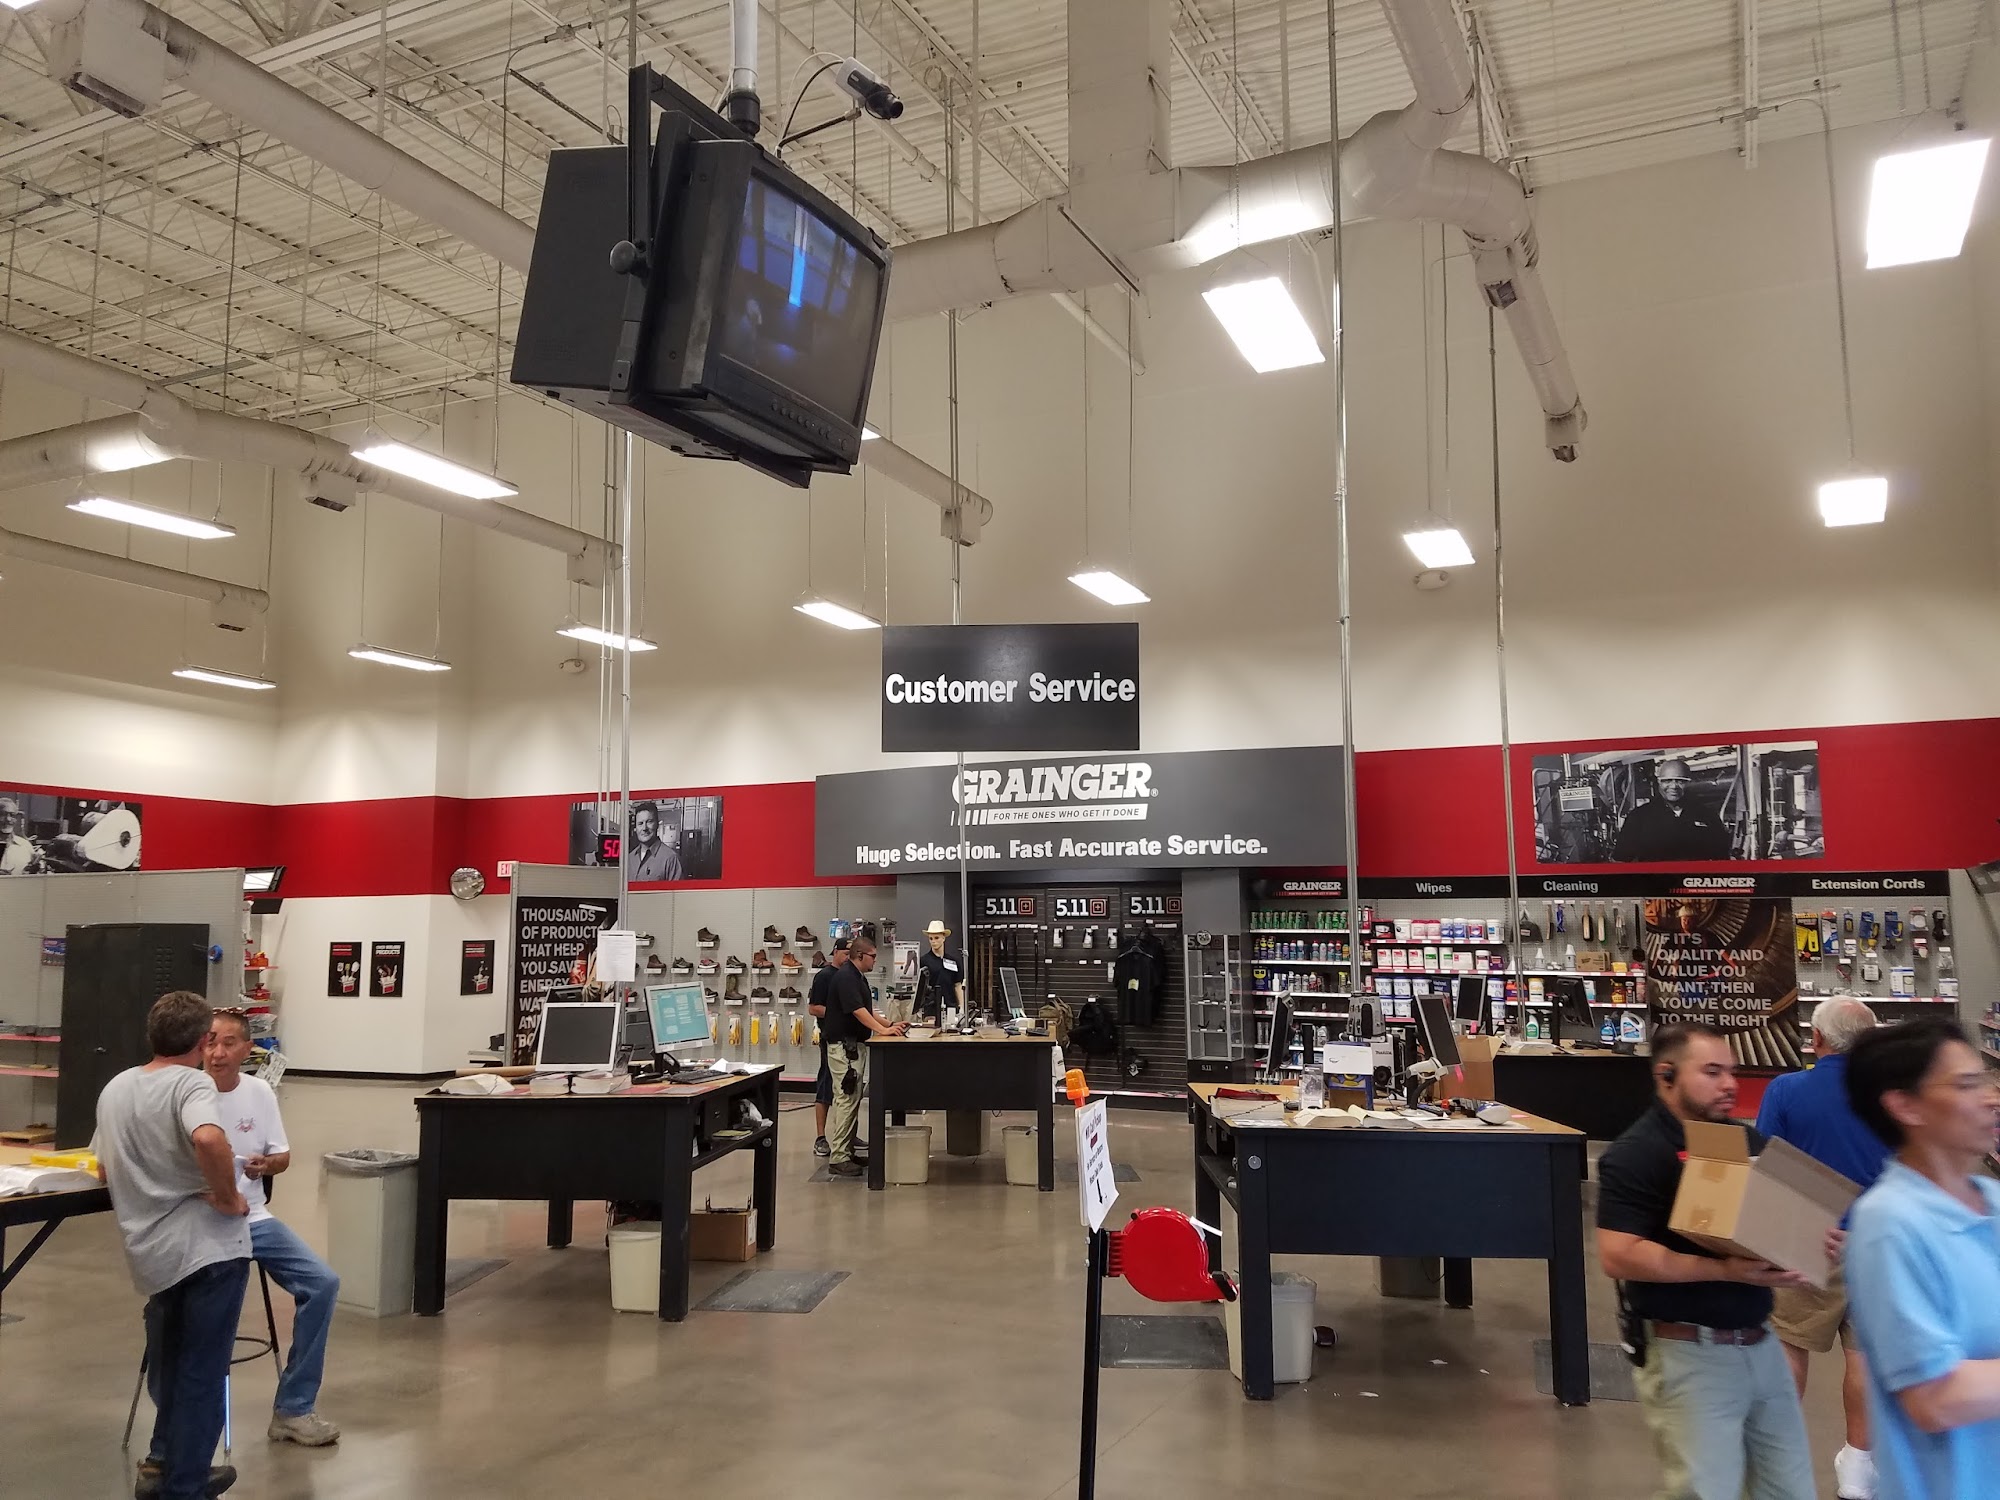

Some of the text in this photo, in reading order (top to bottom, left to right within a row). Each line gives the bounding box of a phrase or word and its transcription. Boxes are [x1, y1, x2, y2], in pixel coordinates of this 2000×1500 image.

[885, 672, 1136, 704] Customer Service
[951, 762, 1152, 805] GRAINGER
[993, 808, 1140, 820] FOR THE ONES WHO GET IT DONE
[856, 846, 901, 867] Huge
[1009, 839, 1053, 859] Fast
[1058, 837, 1162, 858] Accurate
[1167, 834, 1268, 856] Service.
[1283, 881, 1342, 891] GRAINGER
[1415, 882, 1452, 895] Wipes
[1543, 880, 1599, 894] Cleaning
[1682, 877, 1756, 888] GRAINGER
[1811, 878, 1926, 890] Extension Cords
[985, 897, 1018, 915] 5.11
[1056, 898, 1089, 917] 5.11
[1130, 896, 1165, 915] 5.11
[521, 908, 596, 922] THOUSANDS
[521, 926, 540, 940] OF
[1658, 932, 1703, 945] IF IT'S
[521, 943, 585, 957] THAT HELP
[1658, 949, 1765, 962] QUALITY AND
[521, 961, 547, 975] YOU
[1657, 965, 1746, 977] VALUE YOU
[1659, 981, 1755, 995] WANT, THEN
[1658, 998, 1773, 1011] YOU'VE COME
[1659, 1013, 1770, 1028] TO THE RIGHT
